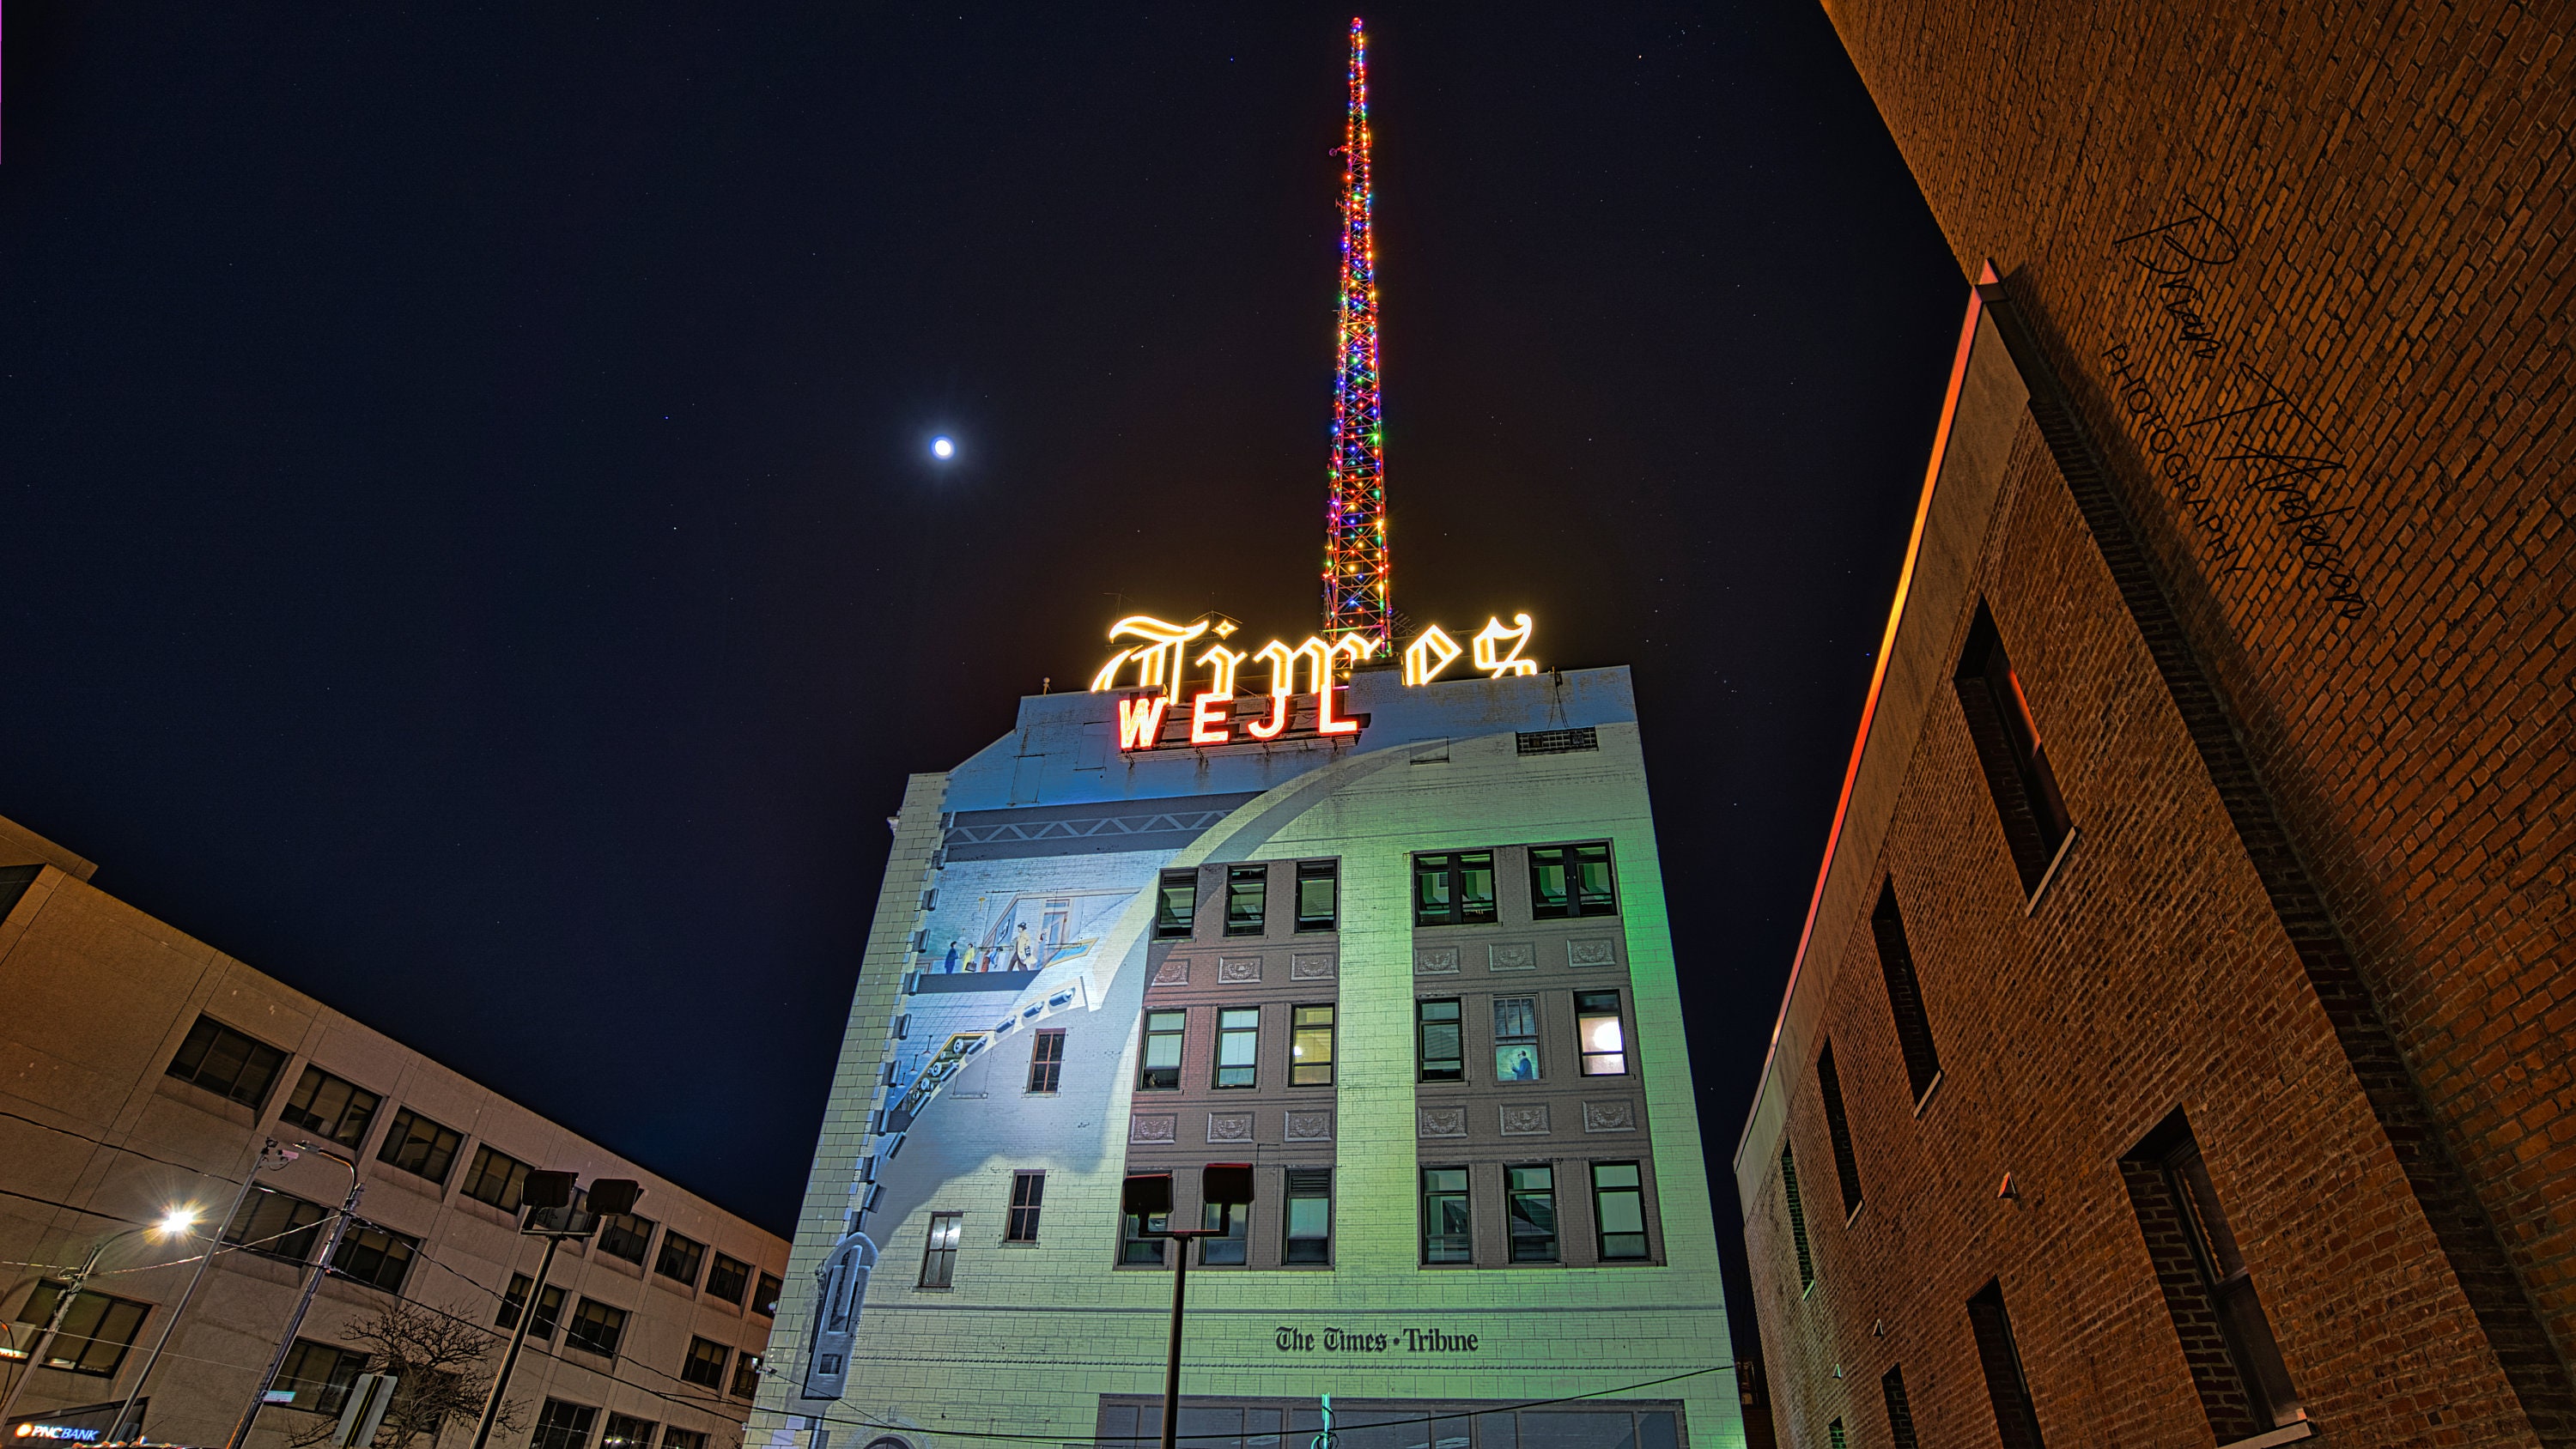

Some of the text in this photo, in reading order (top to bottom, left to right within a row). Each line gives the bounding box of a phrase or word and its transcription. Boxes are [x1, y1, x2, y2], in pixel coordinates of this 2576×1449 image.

[1090, 613, 1539, 706] Times
[1119, 686, 1358, 749] WEJL
[1275, 1325, 1479, 1353] The Times Tribune
